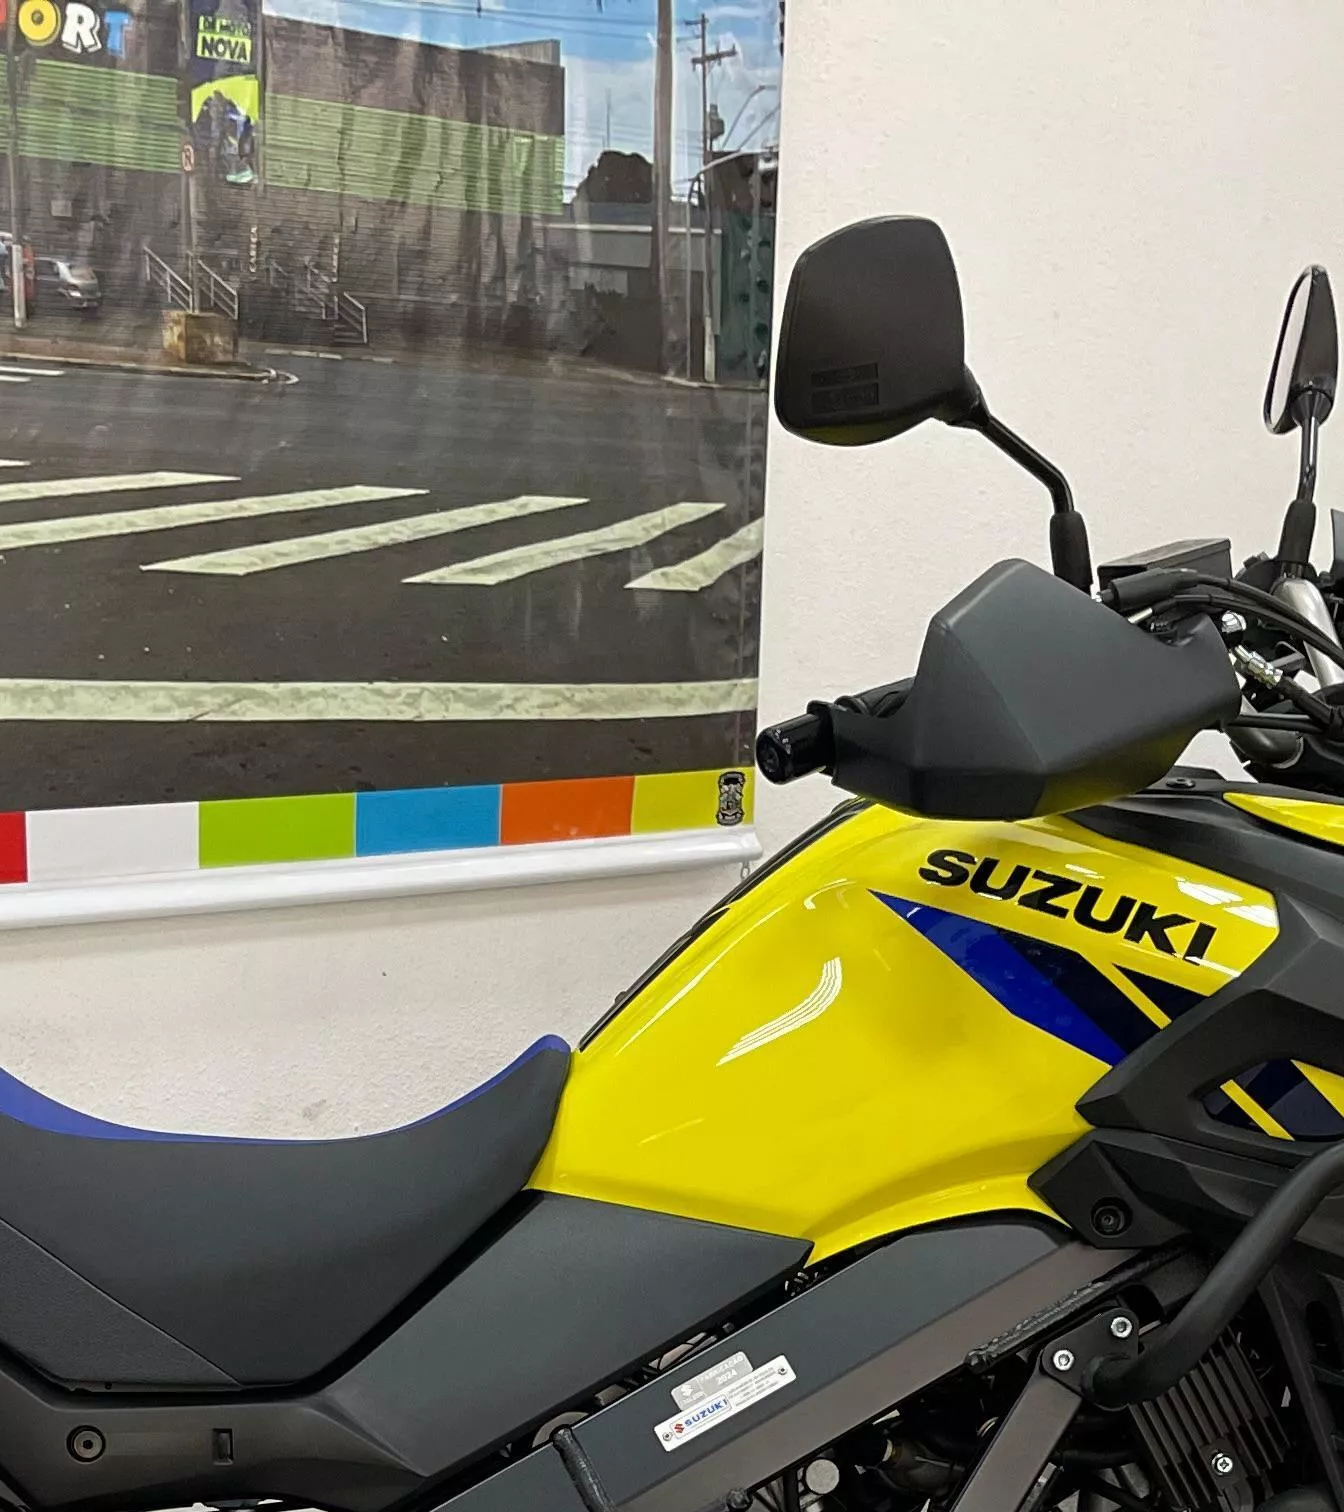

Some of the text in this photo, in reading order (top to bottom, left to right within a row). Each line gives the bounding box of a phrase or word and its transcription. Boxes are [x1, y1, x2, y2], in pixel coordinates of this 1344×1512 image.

[200, 35, 248, 61] NOVA
[917, 848, 1218, 966] SUZUKI
[684, 1398, 728, 1427] SUZUKI
